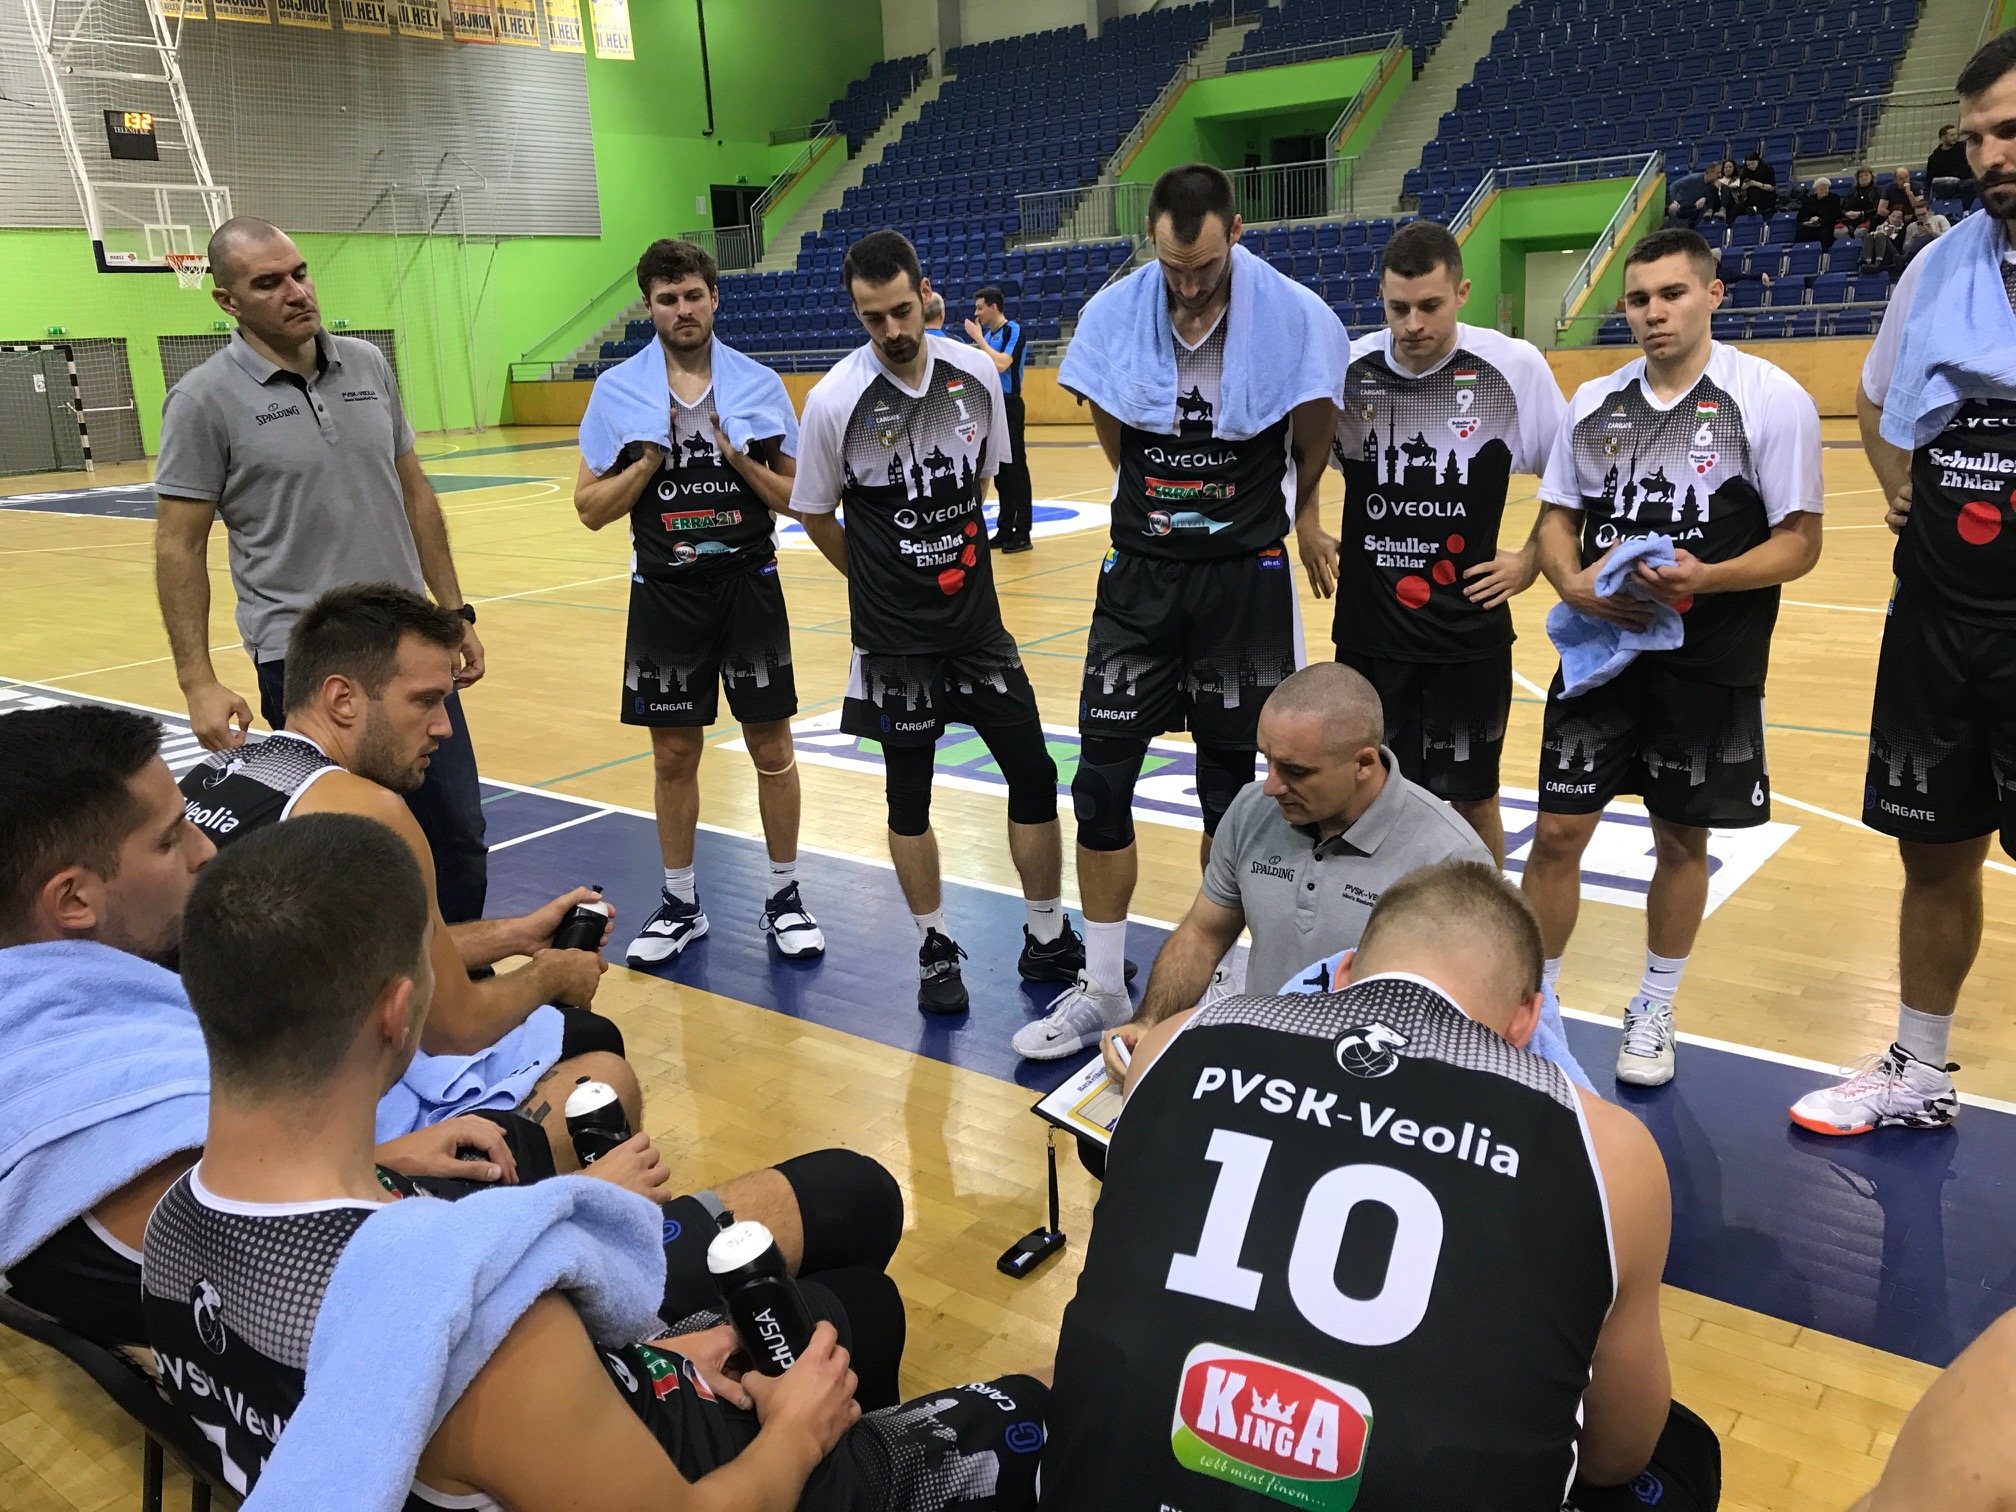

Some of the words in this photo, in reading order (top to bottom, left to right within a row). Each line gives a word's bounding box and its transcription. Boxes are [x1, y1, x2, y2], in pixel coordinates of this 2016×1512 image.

[453, 12, 492, 29] BAJNOK
[955, 399, 970, 420] 1
[1456, 389, 1475, 413] 9
[255, 405, 300, 426] SPALDING
[1694, 422, 1714, 447] 6
[1167, 450, 1238, 468] VEOLIA
[680, 481, 741, 495] VEOLIA
[922, 497, 977, 524] VEOLIA
[1390, 501, 1467, 517] VEOLIA
[661, 509, 716, 531] TERRA
[716, 511, 736, 526] 21
[900, 534, 964, 554] Schuller
[1364, 534, 1440, 554] Schuller
[650, 701, 693, 711] CARGATE
[1090, 708, 1138, 720] CARGATE
[895, 718, 936, 731] CARGATE
[1545, 781, 1597, 795] CARGATE
[1751, 780, 1765, 807] 6
[1880, 799, 1936, 822] CARGATE
[1250, 861, 1295, 882] SPALDING
[1192, 1067, 1520, 1178] PVSK-Veolia
[1165, 1127, 1444, 1347] 10
[1196, 1365, 1340, 1474] KINGA
[1231, 1466, 1265, 1486] mint
